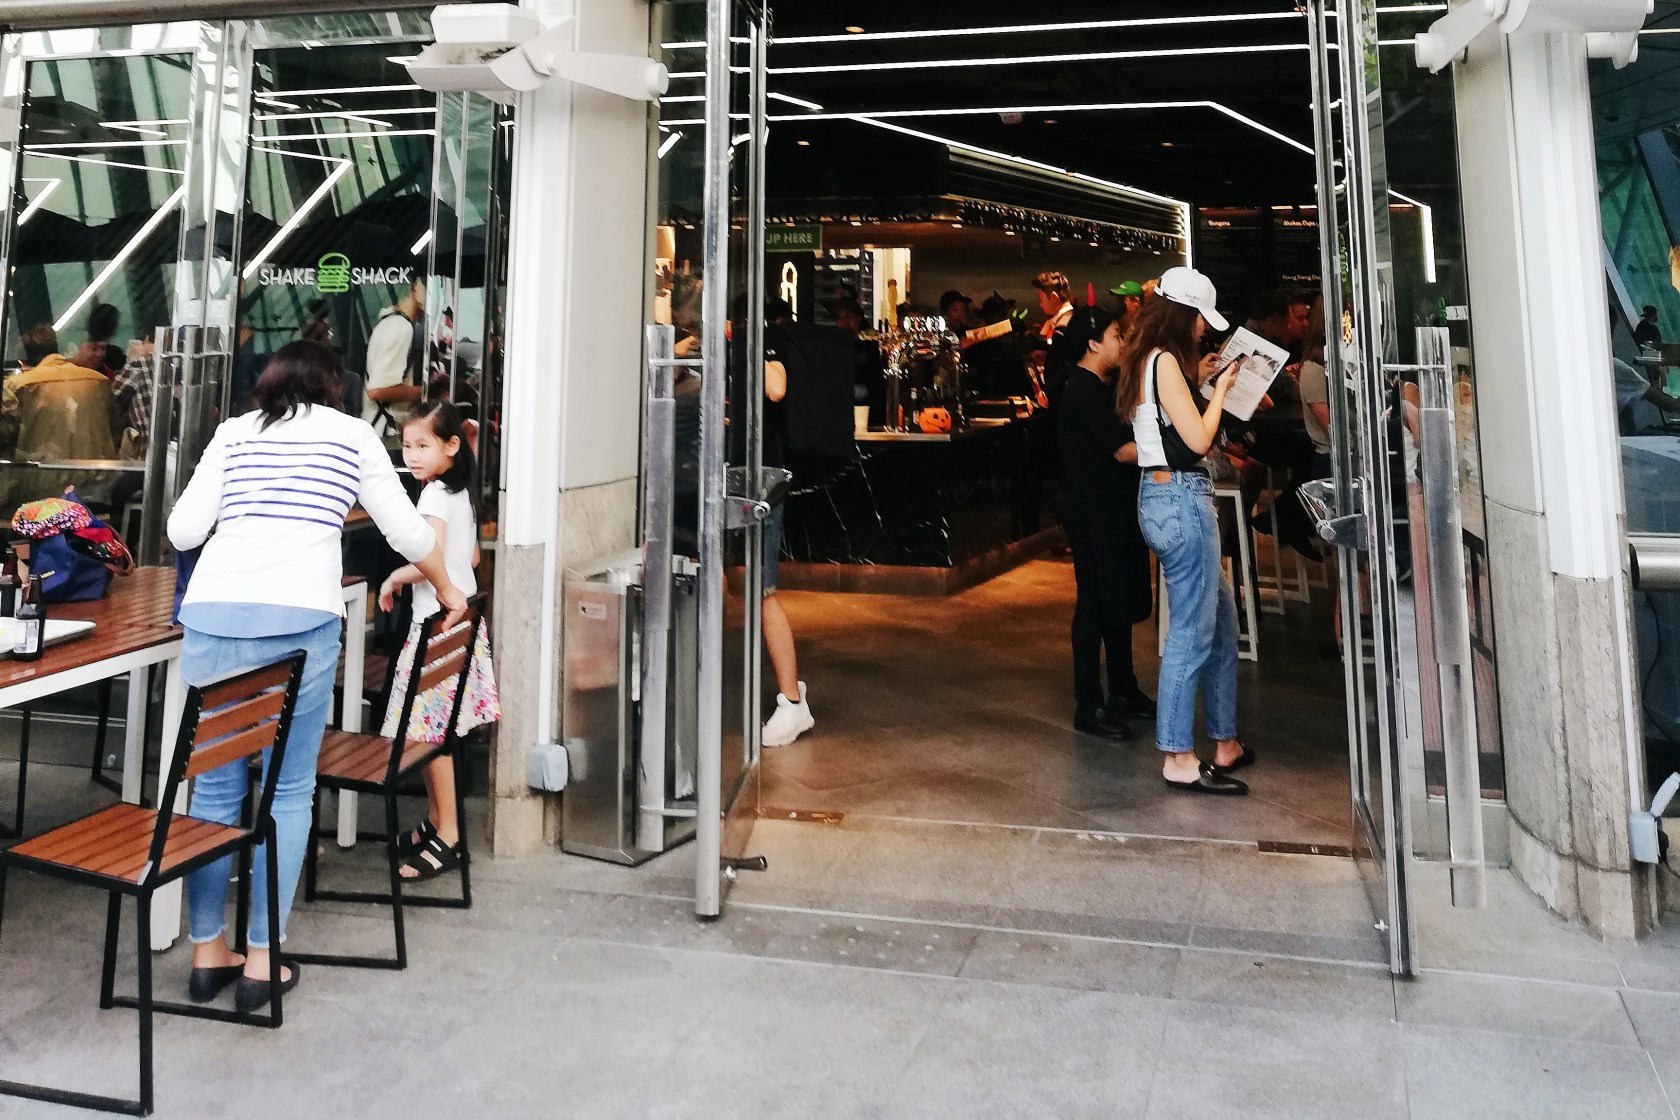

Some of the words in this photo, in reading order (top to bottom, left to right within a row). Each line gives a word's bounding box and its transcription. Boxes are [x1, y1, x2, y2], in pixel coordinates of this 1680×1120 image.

[784, 233, 814, 244] HERE
[259, 269, 315, 285] SHAKE
[351, 267, 410, 285] SHACK
